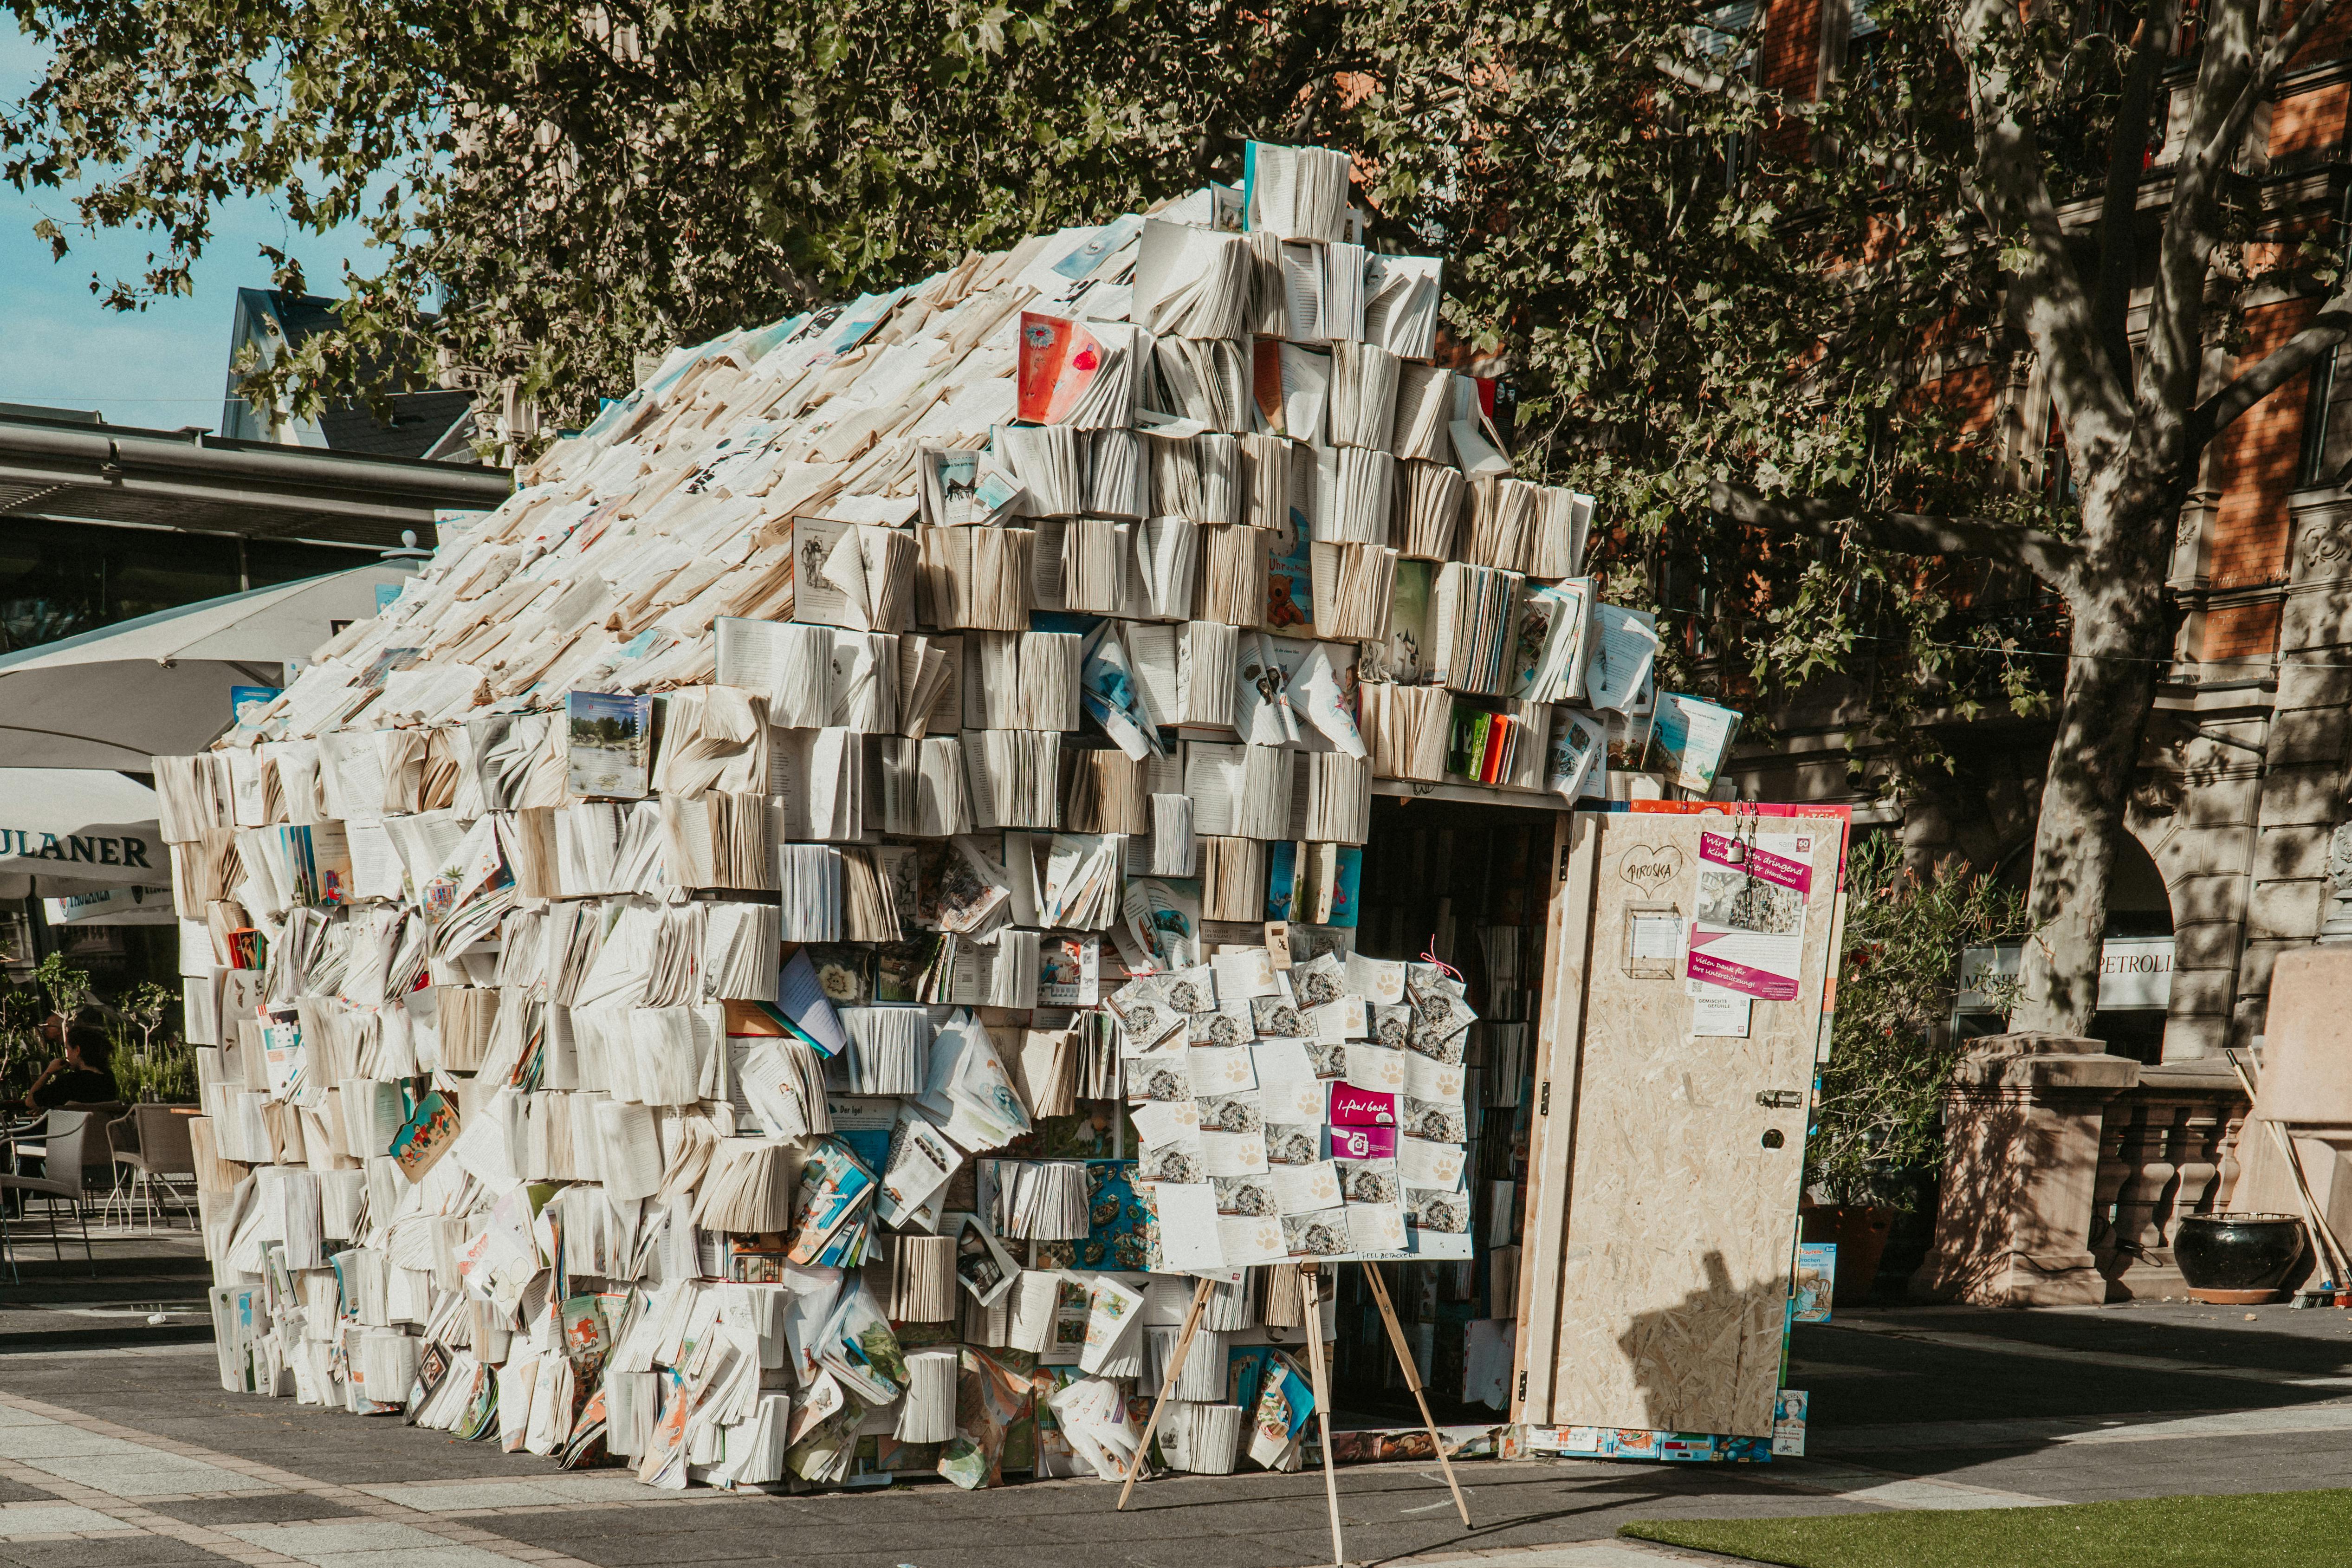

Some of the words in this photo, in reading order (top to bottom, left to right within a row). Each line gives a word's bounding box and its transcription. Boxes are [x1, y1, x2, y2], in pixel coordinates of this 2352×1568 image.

[1798, 839, 1809, 848] 60
[1706, 836, 1724, 848] Wir
[1762, 856, 1804, 876] dringend
[1627, 863, 1671, 882] PIROSKA
[1764, 868, 1796, 885] (Hardcover)
[1695, 956, 1716, 967] Vielen
[1716, 963, 1734, 973] Dank
[1735, 966, 1746, 976] für
[1692, 965, 1704, 974] Ihre
[1705, 968, 1756, 989] Unterstützung!
[840, 1105, 850, 1114] Der
[852, 1105, 862, 1116] Igel
[1342, 1099, 1367, 1118] feel
[1367, 1101, 1388, 1112] best
[1362, 1252, 1379, 1260] FEEL
